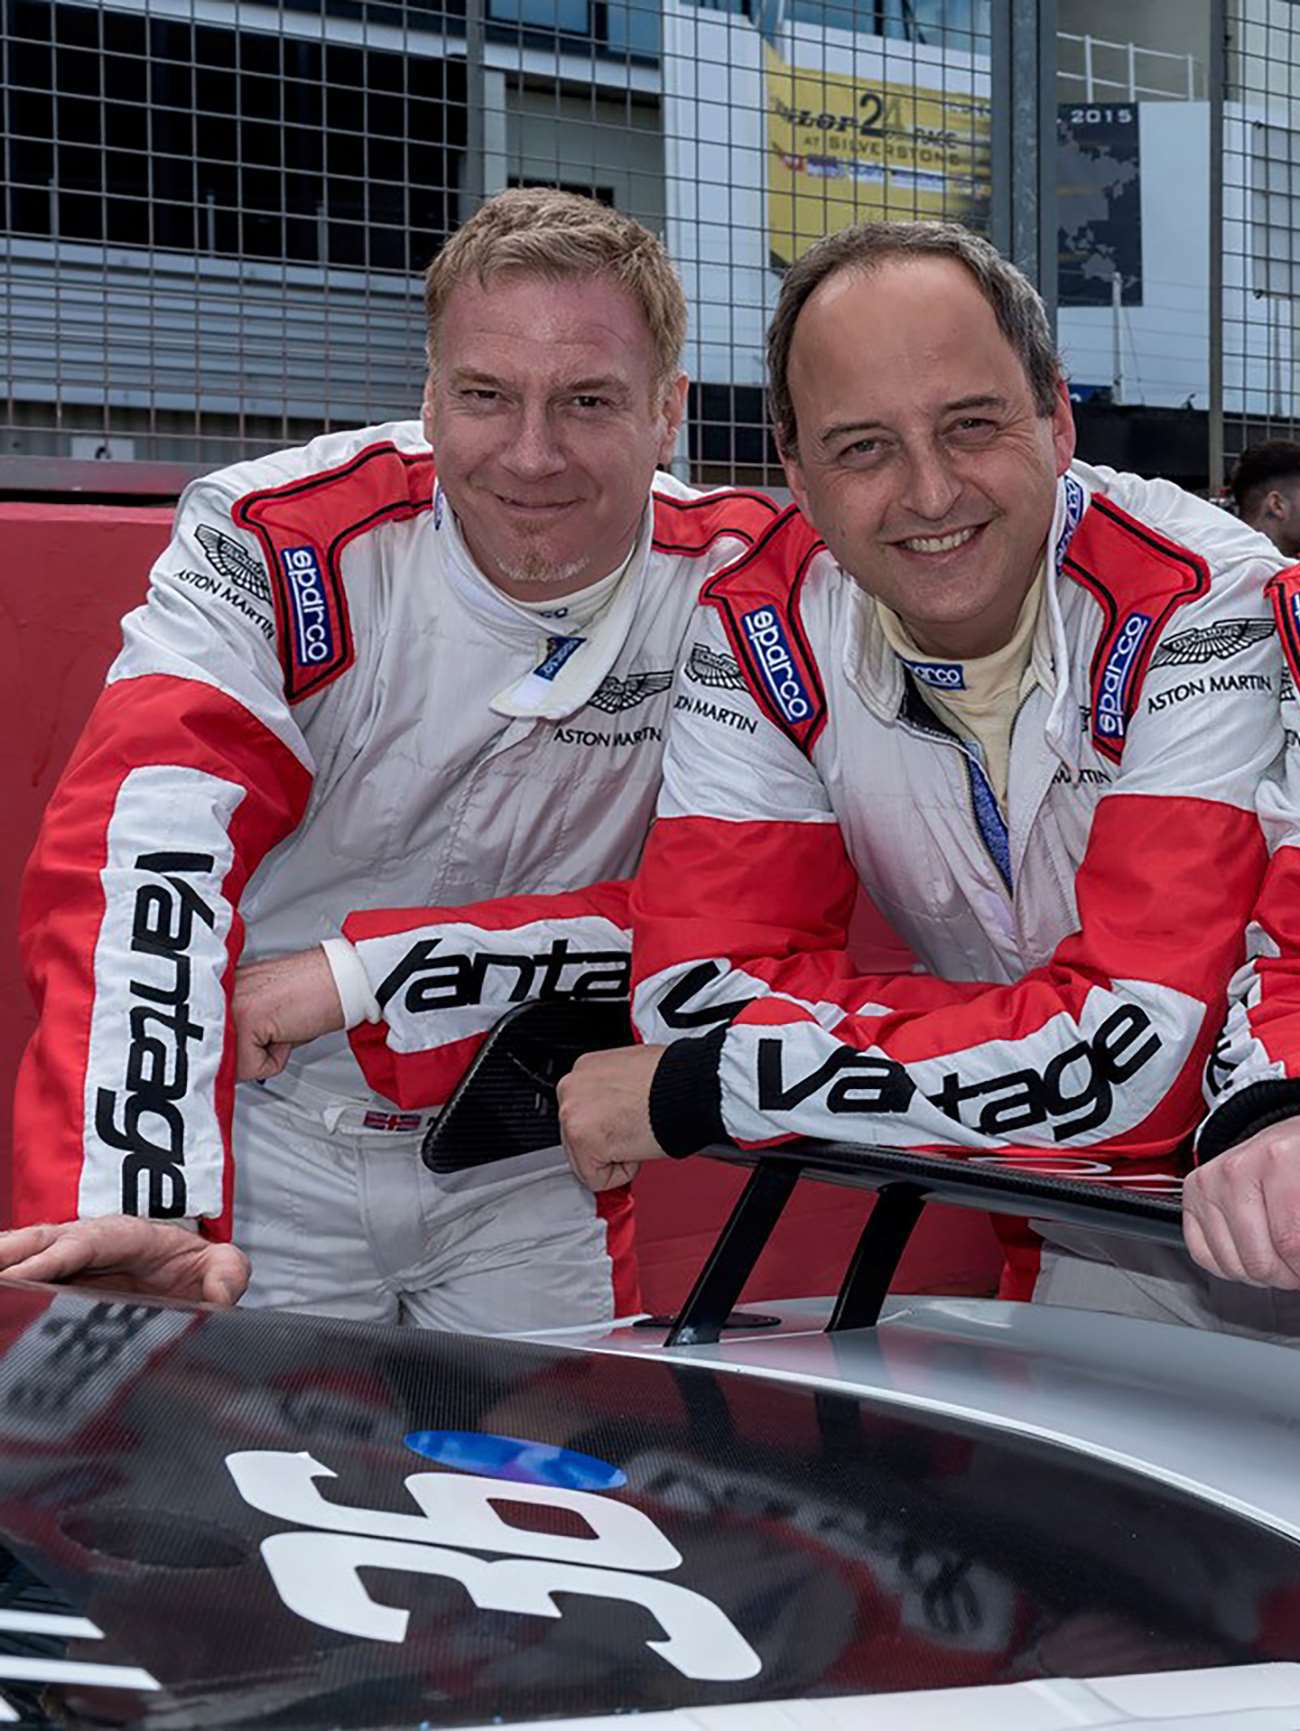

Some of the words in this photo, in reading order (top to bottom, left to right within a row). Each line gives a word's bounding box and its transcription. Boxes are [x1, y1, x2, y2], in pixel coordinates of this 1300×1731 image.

[1071, 109, 1132, 124] 2015
[1148, 679, 1205, 715] ASTON
[1210, 675, 1272, 692] MARTIN
[693, 699, 759, 735] MARTIN
[554, 728, 610, 747] ASTON
[95, 851, 215, 1219] Vantage
[758, 1003, 1163, 1142] Vatage
[225, 1450, 762, 1682] 36
